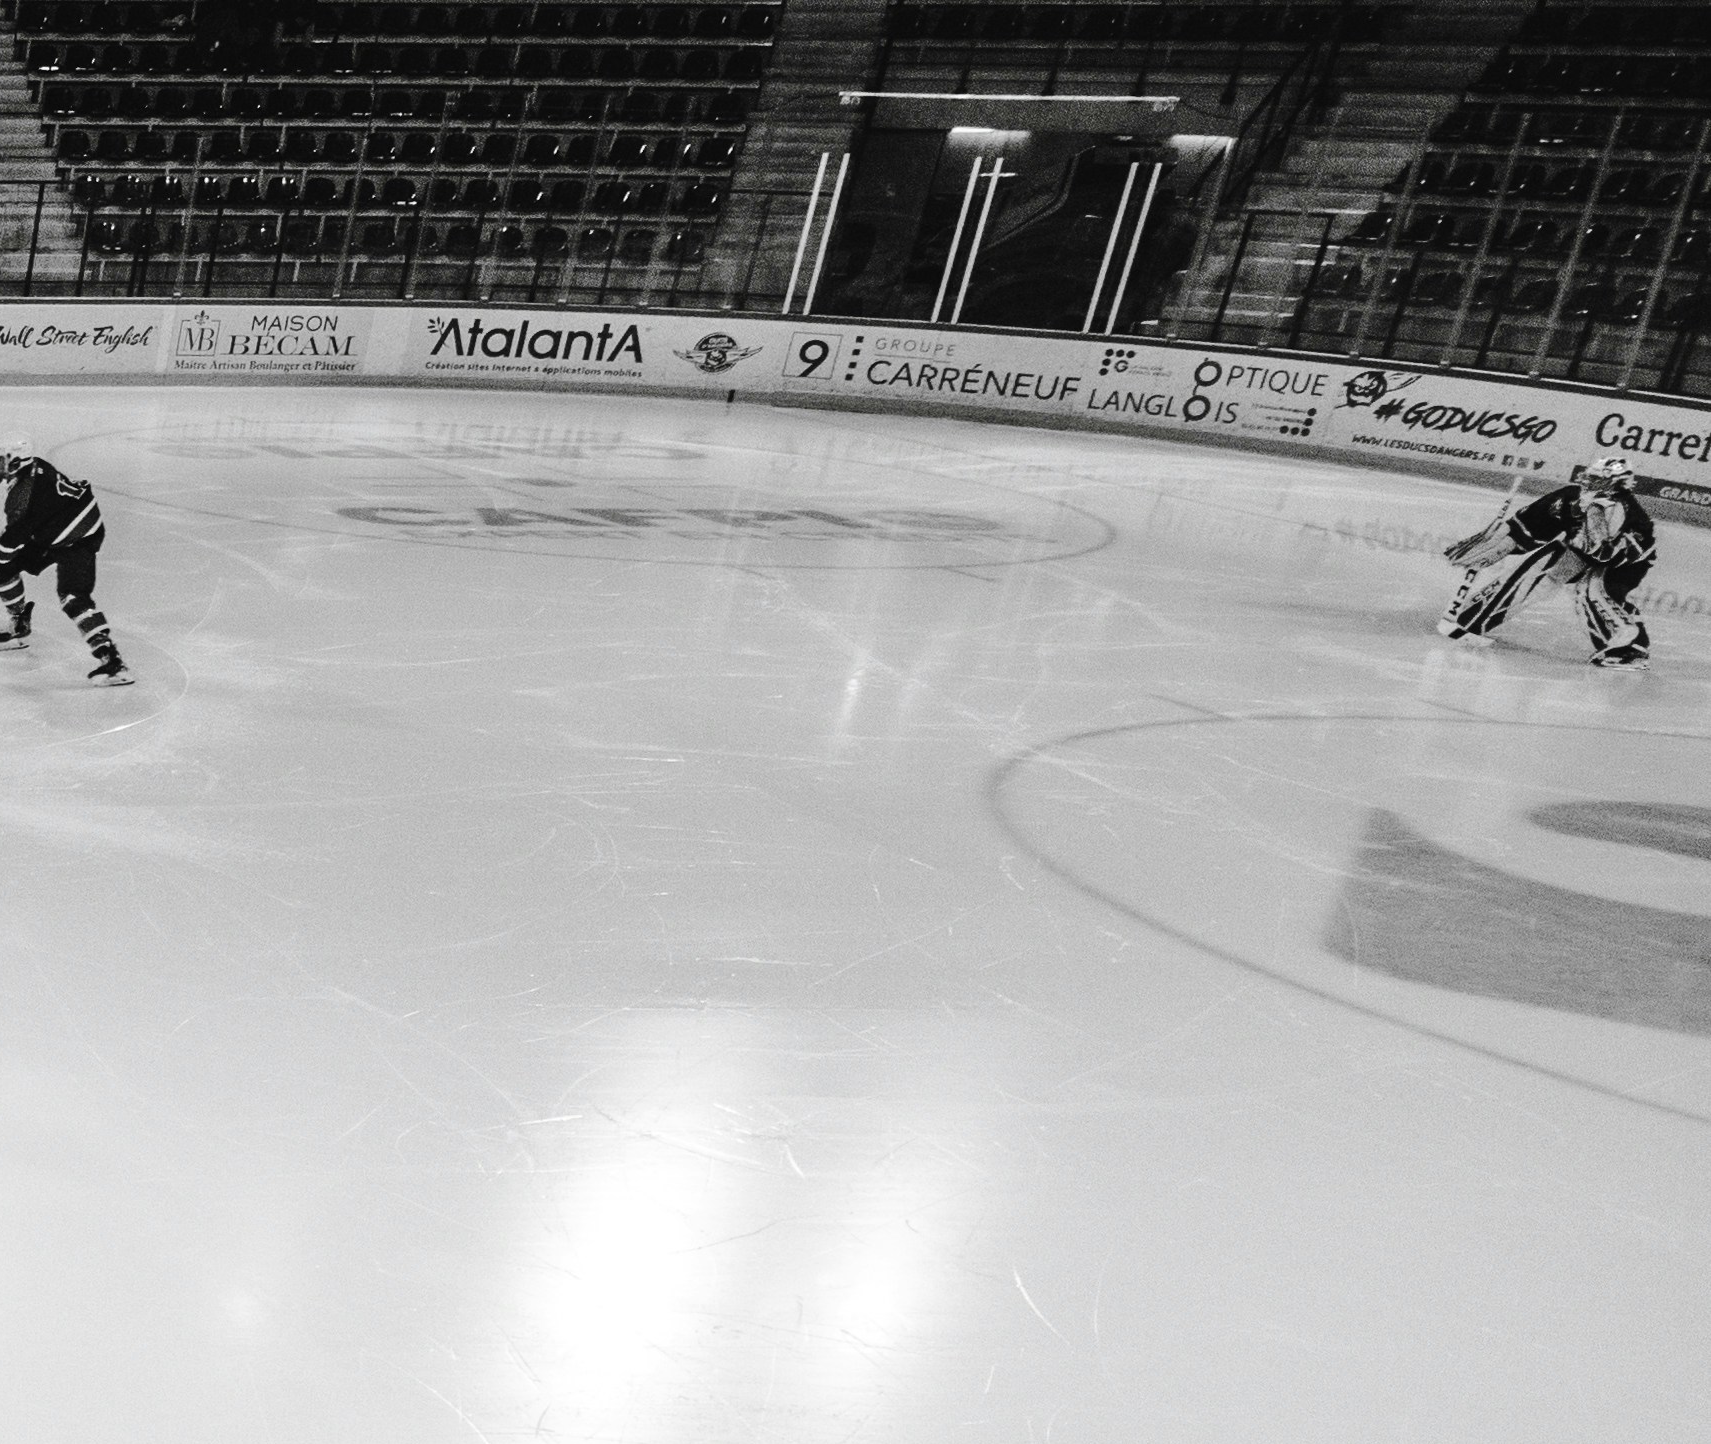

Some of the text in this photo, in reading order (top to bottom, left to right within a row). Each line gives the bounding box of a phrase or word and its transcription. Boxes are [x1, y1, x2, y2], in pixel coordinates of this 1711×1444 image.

[251, 315, 338, 332] MAISON
[36, 325, 89, 346] Street
[92, 325, 154, 354] English
[875, 337, 957, 357] GROUPE
[210, 359, 246, 371] Artisan
[249, 359, 300, 373] Boulanger
[302, 361, 313, 371] et
[467, 363, 490, 371] sites
[604, 368, 642, 378] mobiles
[799, 339, 830, 378] 9
[867, 360, 1082, 401] CARRÉNEUF
[1194, 359, 1329, 396] OPTIQUE
[1087, 388, 1239, 424] LANGLOIS
